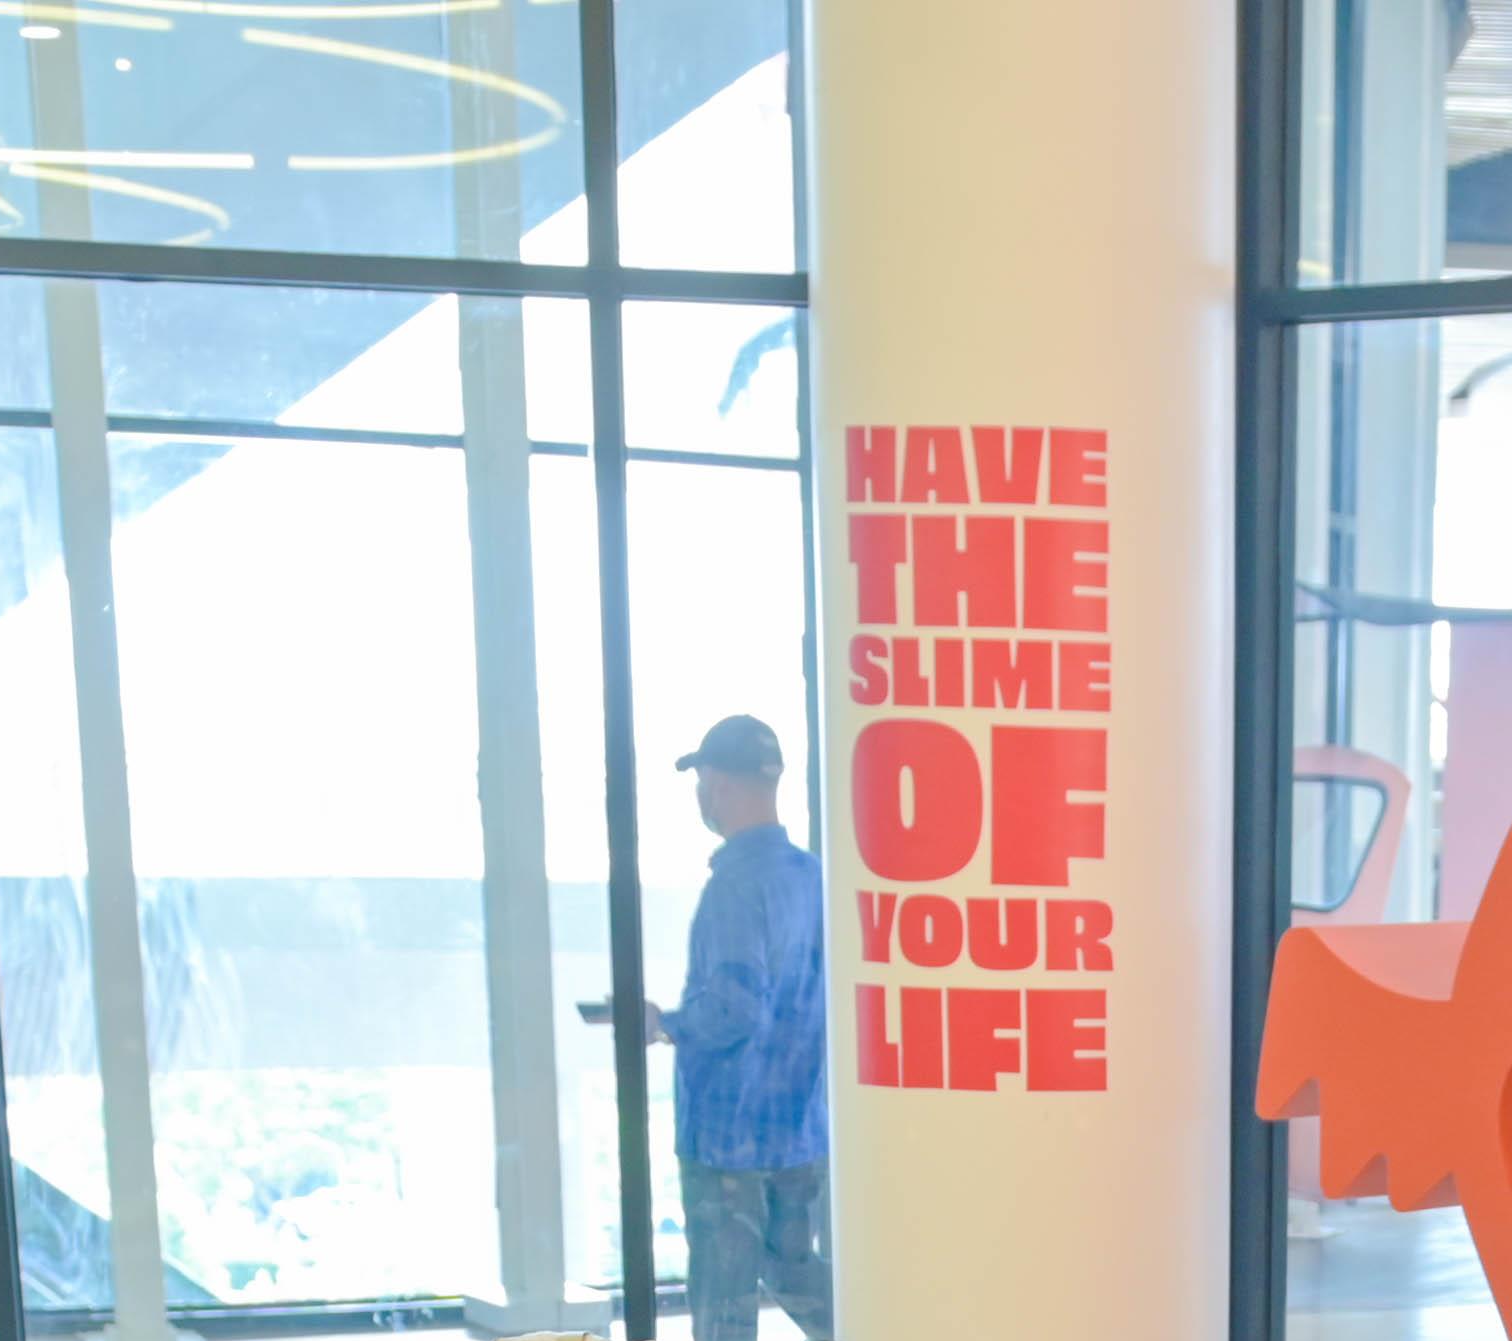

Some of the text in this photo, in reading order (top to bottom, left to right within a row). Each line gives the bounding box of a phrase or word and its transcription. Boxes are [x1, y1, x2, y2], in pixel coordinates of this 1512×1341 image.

[845, 425, 1108, 507] HAVE
[848, 513, 1110, 633] THE
[848, 634, 1112, 712] SLIME
[851, 718, 1108, 887] OF
[855, 890, 1114, 972] YOUR
[855, 983, 1108, 1092] LIFE
